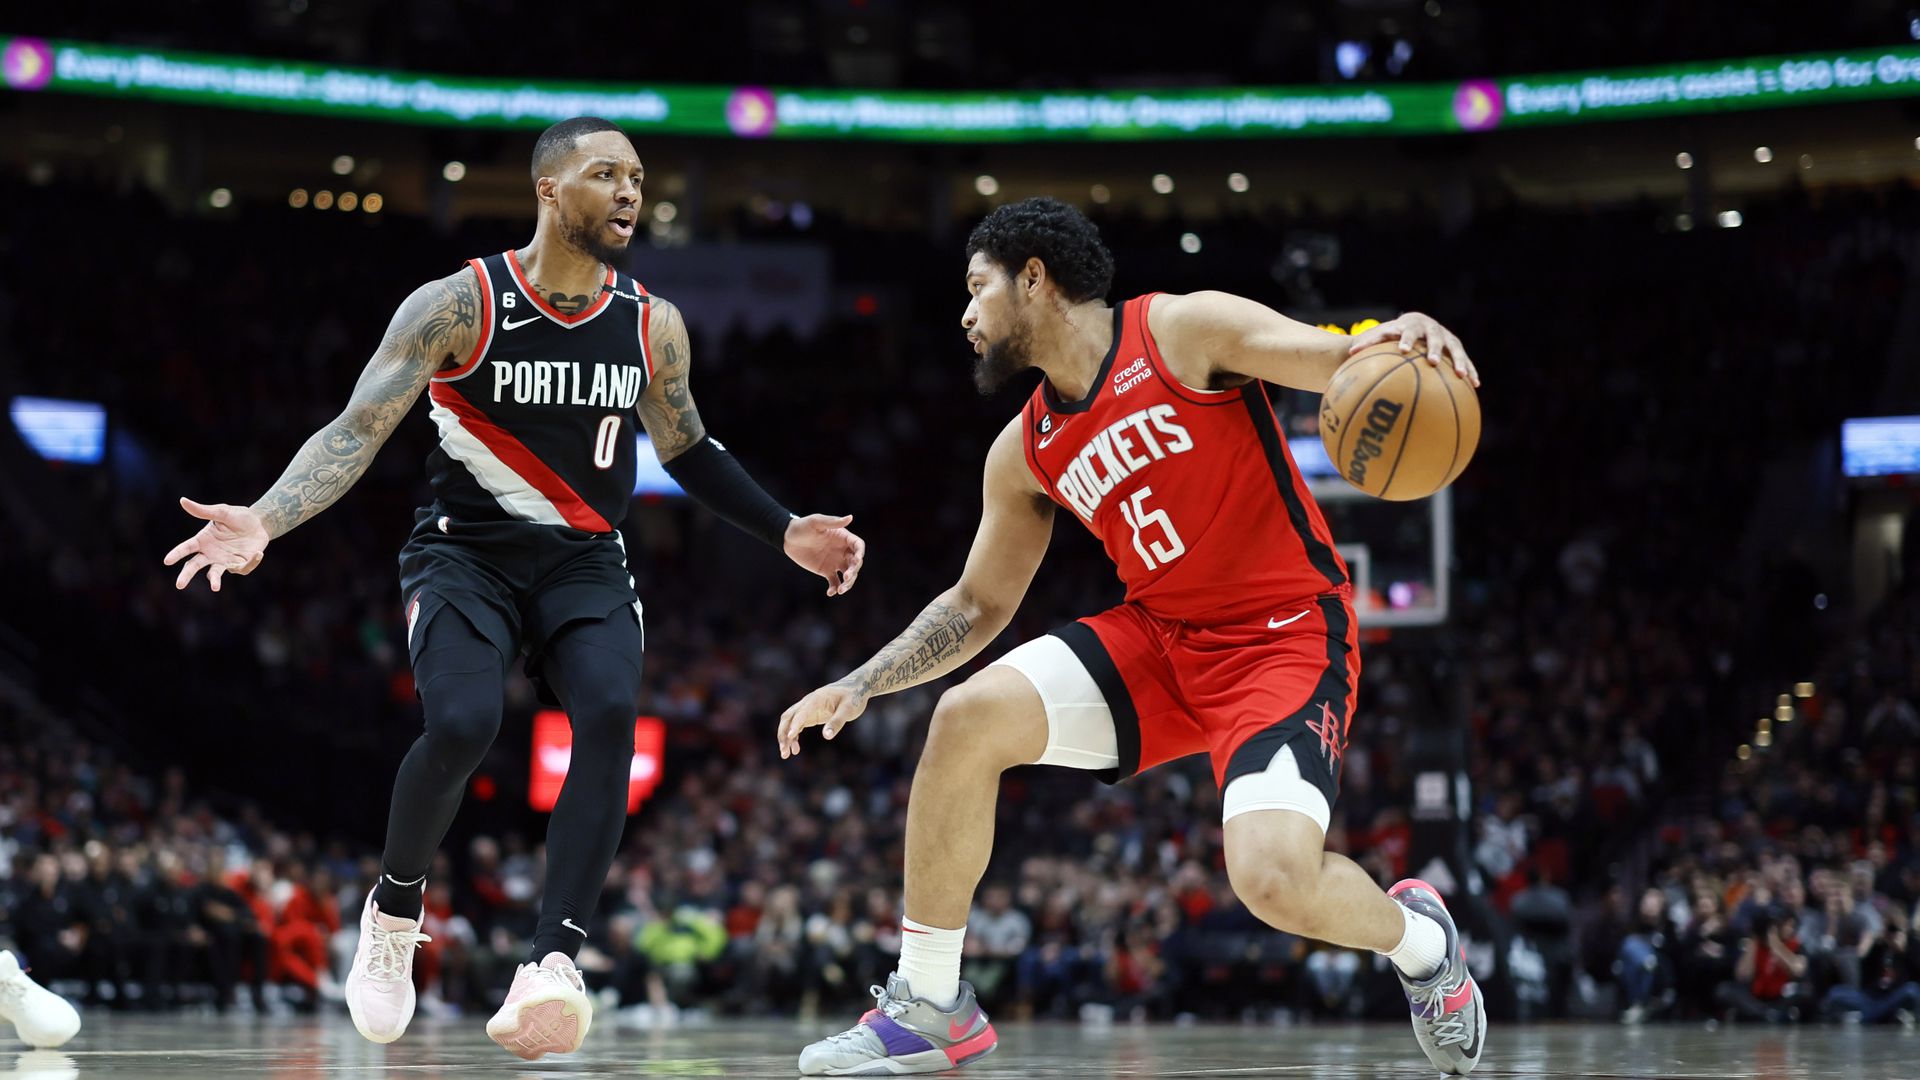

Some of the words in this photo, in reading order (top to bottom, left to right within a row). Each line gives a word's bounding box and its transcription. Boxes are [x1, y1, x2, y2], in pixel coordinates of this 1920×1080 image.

[502, 292, 516, 308] 6
[491, 361, 642, 409] PORTLAND
[1113, 368, 1152, 396] karma
[1114, 357, 1147, 383] credit
[594, 414, 622, 469] 0
[1041, 414, 1051, 433] 6
[1348, 397, 1405, 486] Wilson
[1055, 403, 1194, 523] ROCKETS
[1119, 485, 1186, 571] 15
